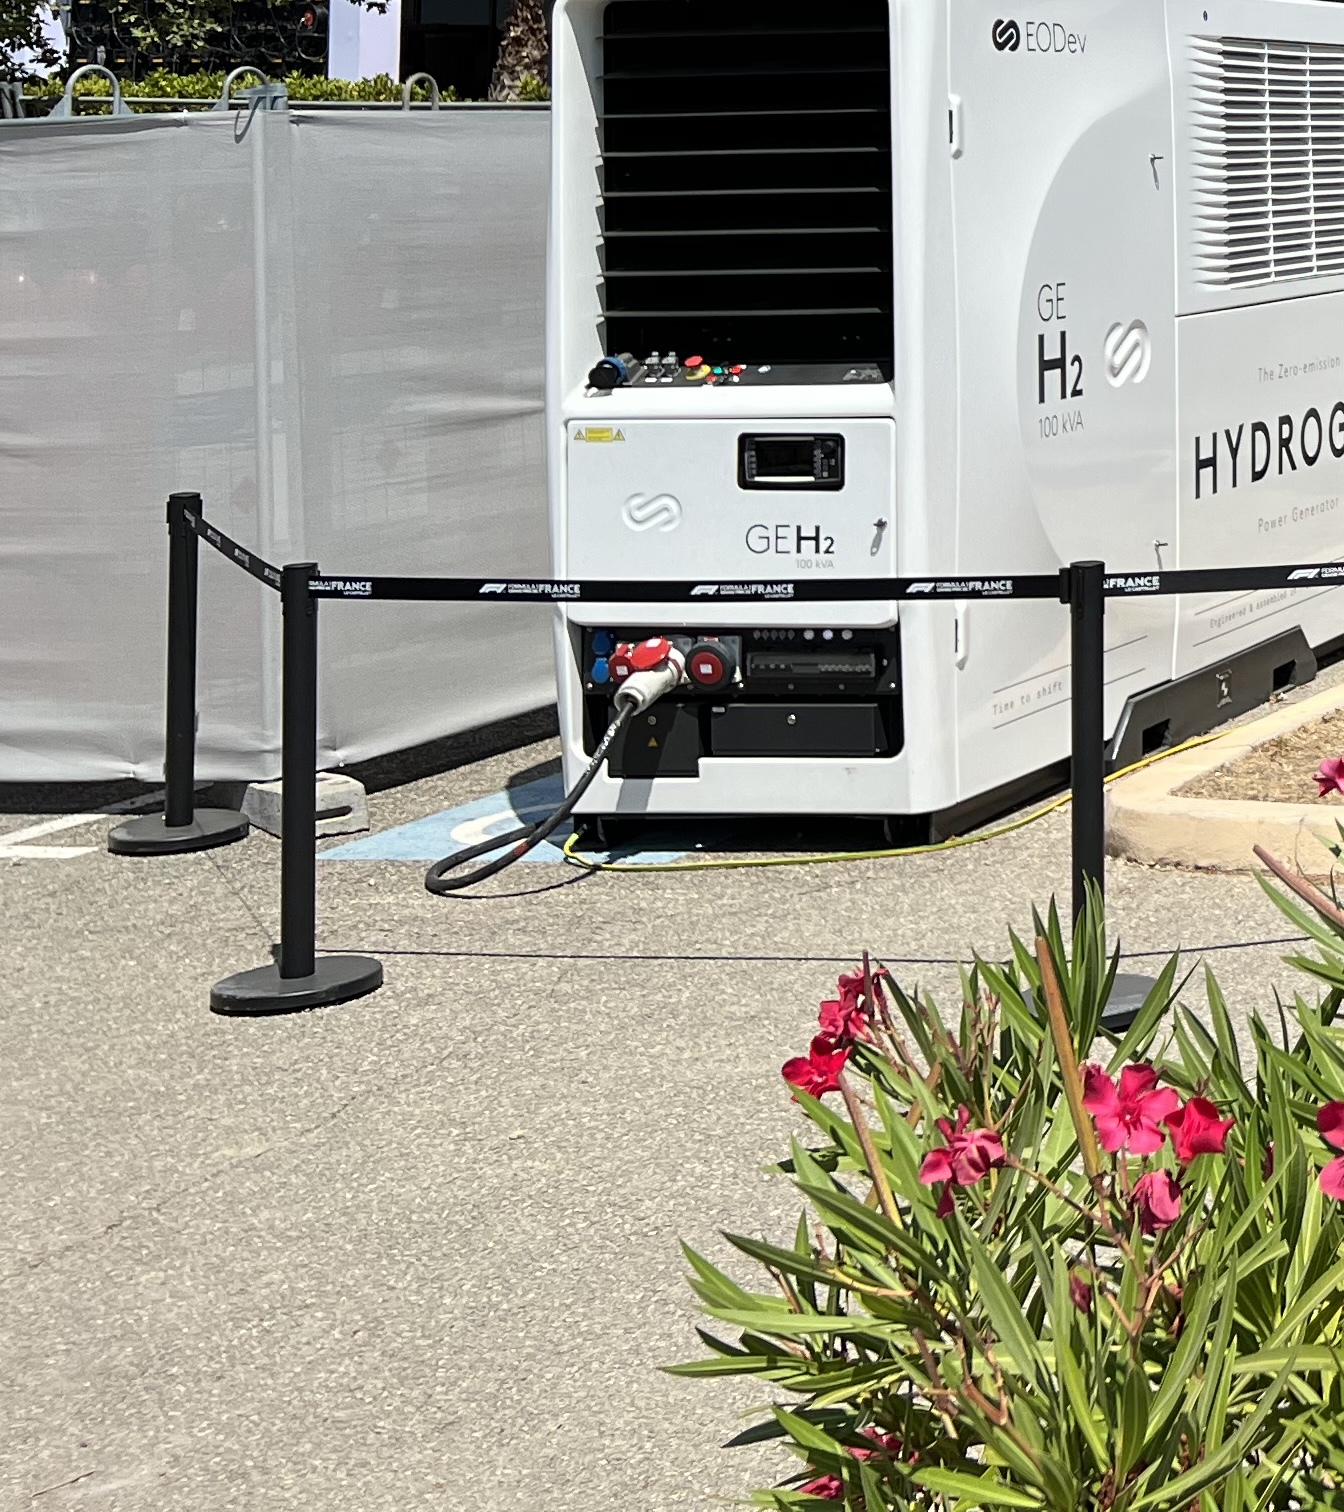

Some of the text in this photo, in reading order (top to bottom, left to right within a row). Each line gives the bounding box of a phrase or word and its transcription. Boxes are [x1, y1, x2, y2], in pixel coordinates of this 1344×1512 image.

[1025, 20, 1088, 54] EODev
[1037, 282, 1067, 323] GE
[1258, 355, 1341, 383] The Zero-emission
[1038, 409, 1085, 439] 100 kVA
[1257, 497, 1340, 534] Power Generator
[795, 558, 835, 569] 100 kVA
[331, 581, 373, 591] FRANCE
[538, 583, 581, 594] FRANCE
[751, 583, 795, 594] FRANCE
[968, 580, 1013, 592] FRANCE
[1109, 575, 1160, 589] FRANCE
[992, 680, 1063, 716] Time to shift
